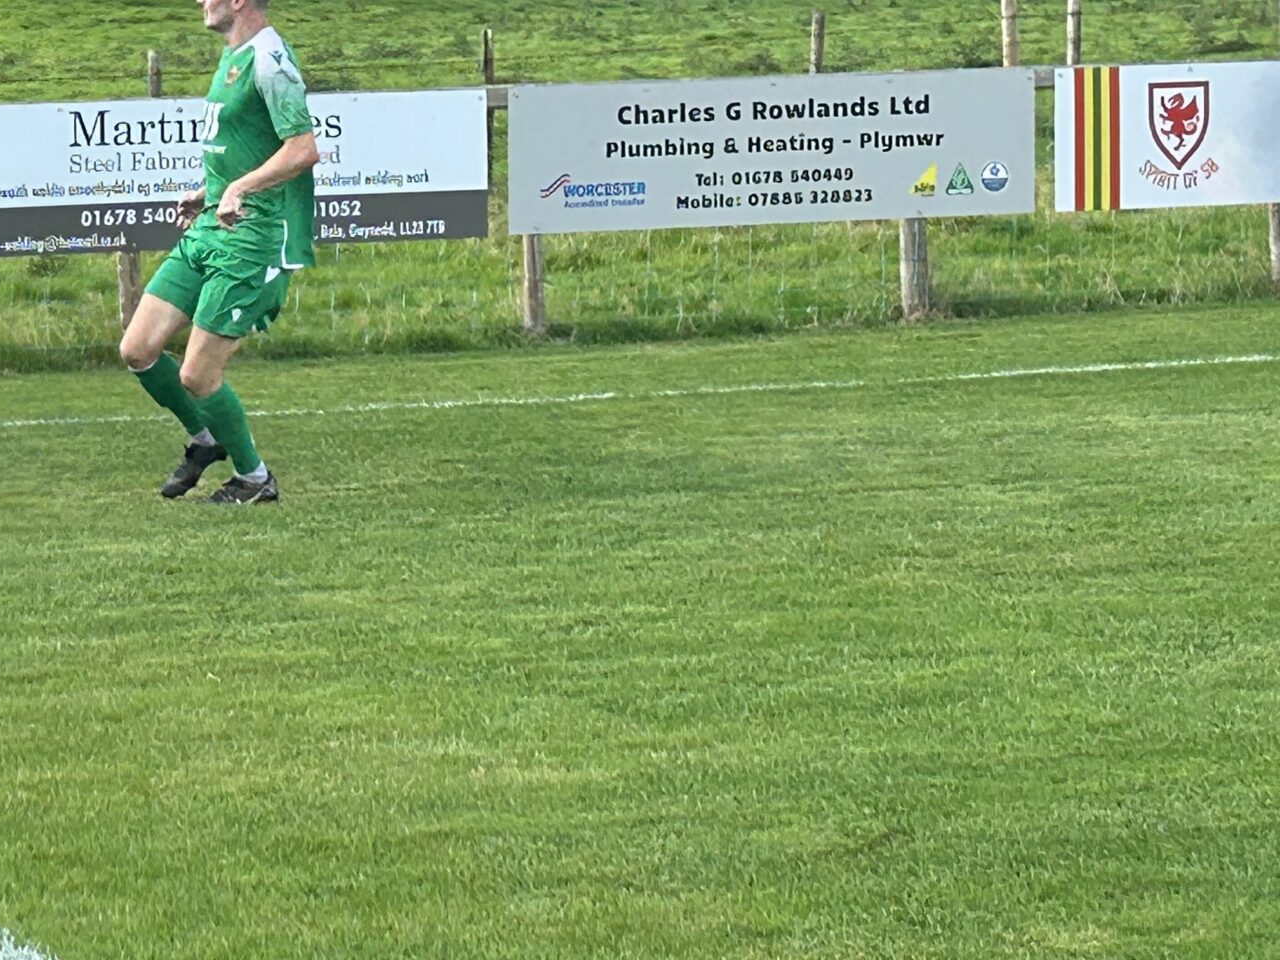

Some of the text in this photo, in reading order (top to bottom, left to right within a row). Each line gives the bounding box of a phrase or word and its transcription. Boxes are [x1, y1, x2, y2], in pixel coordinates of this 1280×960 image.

[617, 93, 930, 125] Charles G Rowlands Ltd
[605, 138, 715, 160] Plumbing
[723, 137, 739, 154] &
[747, 132, 834, 155] Heating
[859, 130, 945, 153] Plymwr
[69, 149, 204, 174] Steel Fabric
[562, 181, 647, 199] WORCESTER
[80, 208, 138, 227] 01678
